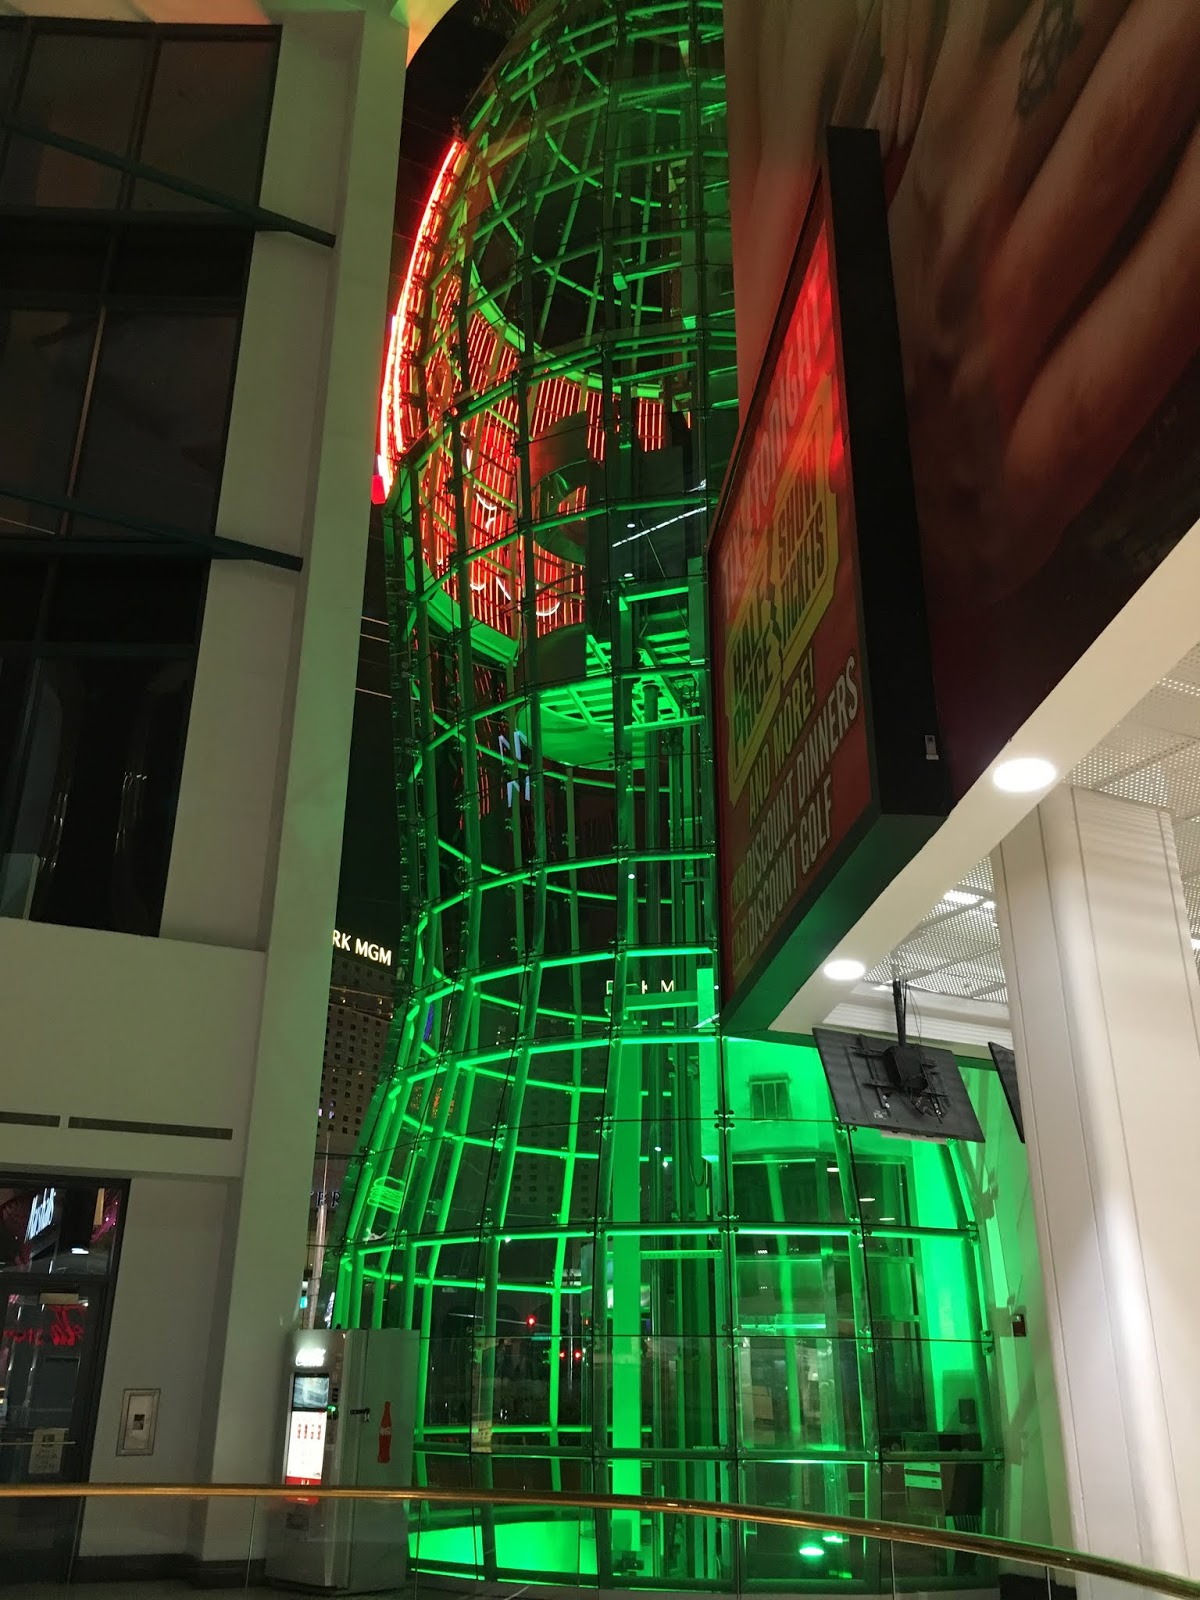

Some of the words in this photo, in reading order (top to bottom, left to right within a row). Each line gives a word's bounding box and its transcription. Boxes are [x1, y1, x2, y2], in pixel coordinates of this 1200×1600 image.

[733, 577, 767, 703] HALF
[778, 430, 817, 582] SHOW
[733, 625, 772, 768] PRICE
[780, 498, 825, 649] TICKETS
[746, 768, 793, 898] DISCOUNT
[797, 655, 858, 808] DINNERS
[750, 743, 770, 828] AND
[773, 647, 815, 777] MORE!
[355, 937, 392, 967] MGM
[748, 832, 797, 955] DISCOUNT
[800, 774, 832, 874] GOLF
